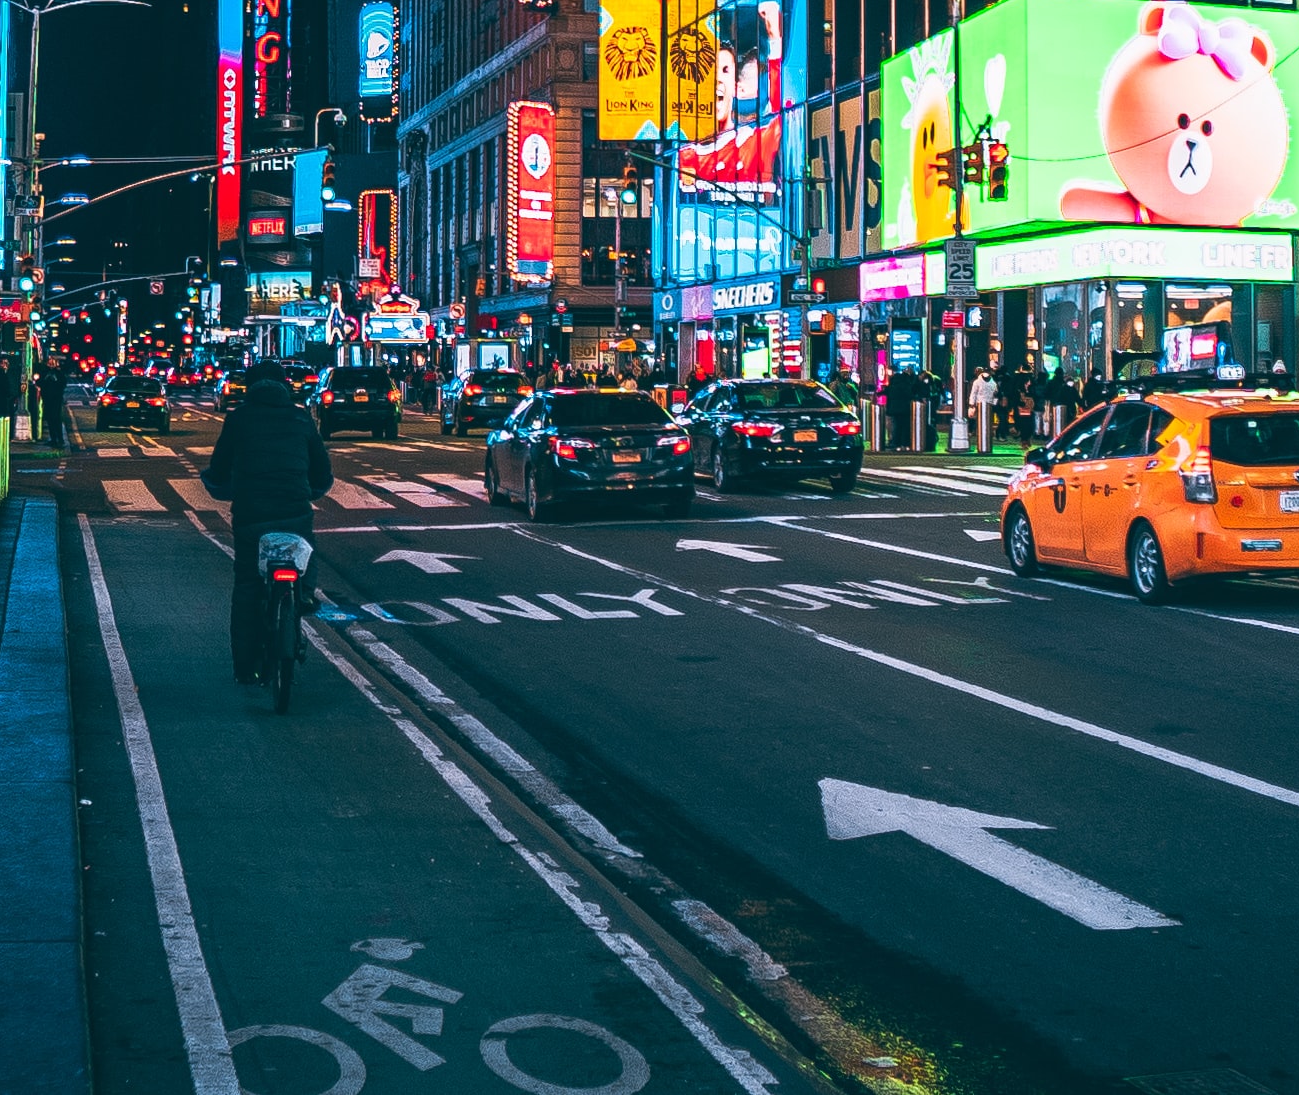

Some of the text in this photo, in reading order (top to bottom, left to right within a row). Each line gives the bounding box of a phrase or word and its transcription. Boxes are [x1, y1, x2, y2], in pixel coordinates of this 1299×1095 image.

[606, 99, 654, 112] LION KING
[251, 219, 286, 236] NETFLIX
[949, 264, 974, 279] 25
[713, 281, 774, 310] SKECHERS
[358, 587, 686, 625] ONLY
